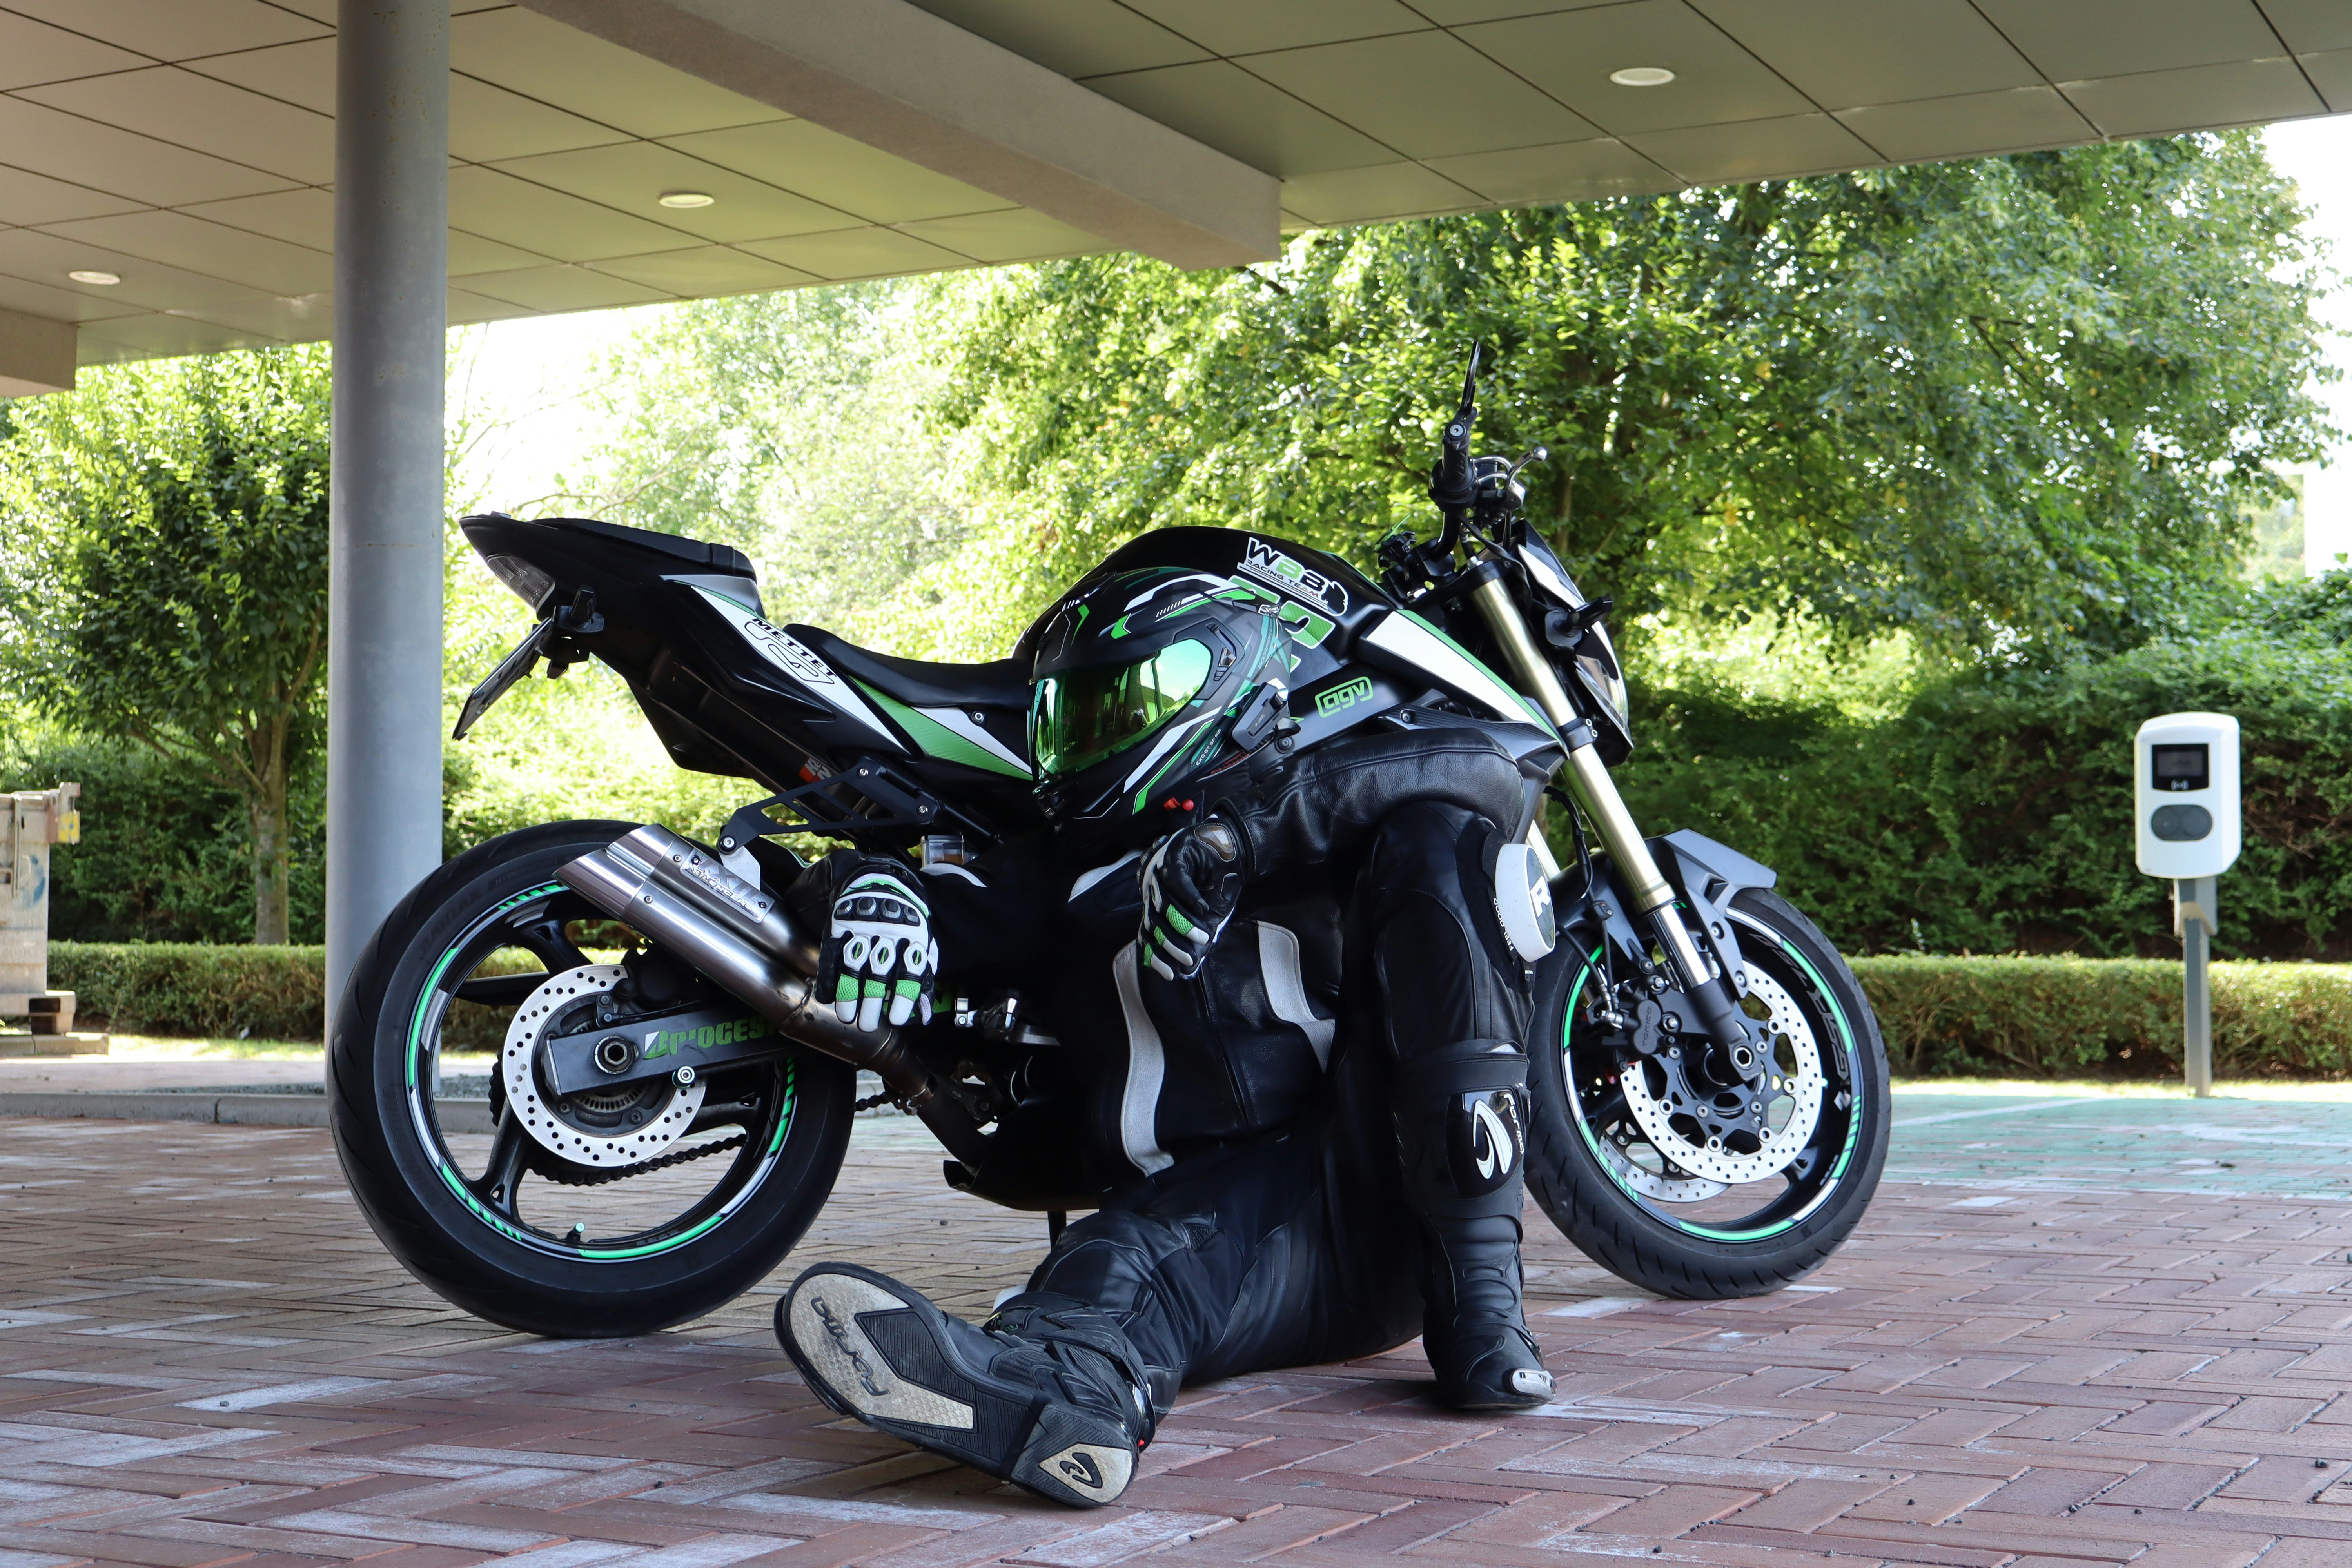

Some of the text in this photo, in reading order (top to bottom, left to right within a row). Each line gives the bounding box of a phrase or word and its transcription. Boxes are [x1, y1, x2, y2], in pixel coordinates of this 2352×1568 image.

[1247, 559, 1318, 598] RACING TEAM
[1249, 539, 1325, 592] WBB
[751, 618, 837, 678] METTET
[1258, 632, 1272, 669] SCORPION
[1323, 682, 1368, 709] agv
[1257, 713, 1265, 724] cardo
[1209, 737, 1216, 746] SP
[698, 858, 760, 905] IXIL
[1530, 875, 1552, 918] R
[1642, 1006, 1652, 1047] TOKICO
